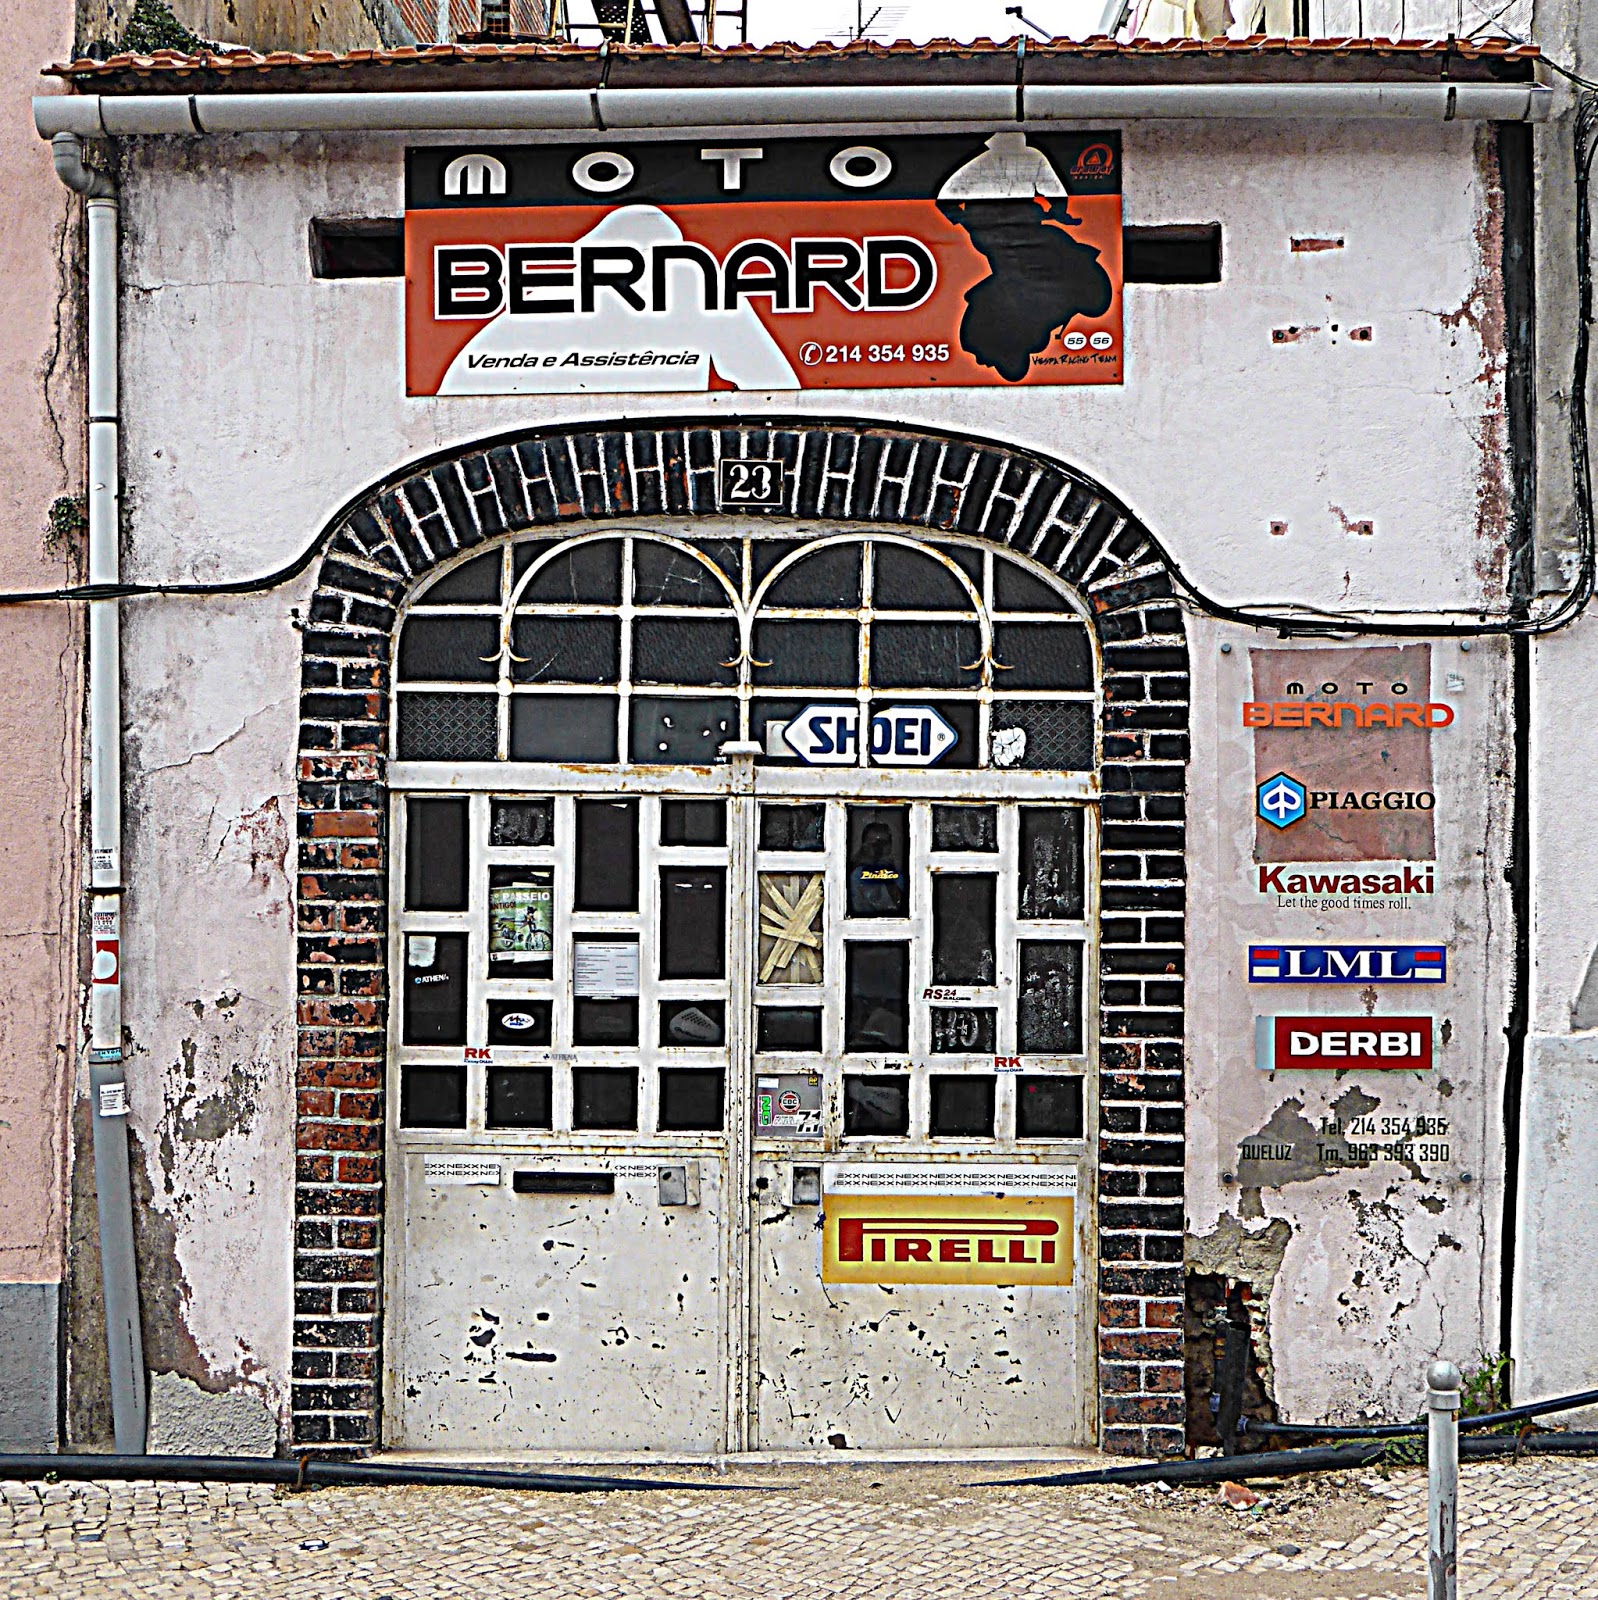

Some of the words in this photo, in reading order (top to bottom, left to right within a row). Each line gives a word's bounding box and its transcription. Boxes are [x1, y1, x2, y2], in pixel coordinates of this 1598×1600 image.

[444, 146, 893, 196] MOTO
[434, 237, 938, 320] BERNARD
[1067, 337, 1084, 345] 55
[1093, 337, 1110, 345] 56
[467, 353, 539, 369] Venda
[542, 356, 558, 367] e
[559, 350, 700, 367] Assistência
[825, 344, 862, 362] 214
[868, 344, 906, 362] 354
[912, 344, 950, 362] 935
[730, 464, 771, 499] 23
[1286, 682, 1408, 695] MOTO
[1242, 702, 1454, 728] BERNARD
[1309, 791, 1436, 810] PIAGGIO
[1259, 866, 1434, 894] Kawasaki
[502, 892, 550, 901] PASSEIO
[1277, 895, 1297, 908] Let
[1300, 896, 1318, 908] the
[1321, 896, 1350, 911] good
[1353, 896, 1385, 909] times
[1388, 897, 1411, 910] roll.
[1284, 949, 1413, 979] LML
[465, 1048, 491, 1059] RK
[1290, 1031, 1421, 1057] DERBI
[994, 1057, 1022, 1068] RK
[1320, 1117, 1345, 1136] Tel.
[1350, 1117, 1376, 1135] 214
[1381, 1117, 1411, 1135] 354
[1416, 1116, 1446, 1136] 935
[1242, 1144, 1292, 1161] QUELUZ
[1316, 1143, 1344, 1161] Tm.
[1349, 1144, 1378, 1161] 963
[1384, 1144, 1414, 1161] 393
[1419, 1144, 1450, 1161] 390
[838, 1218, 1059, 1264] PIRELLI
